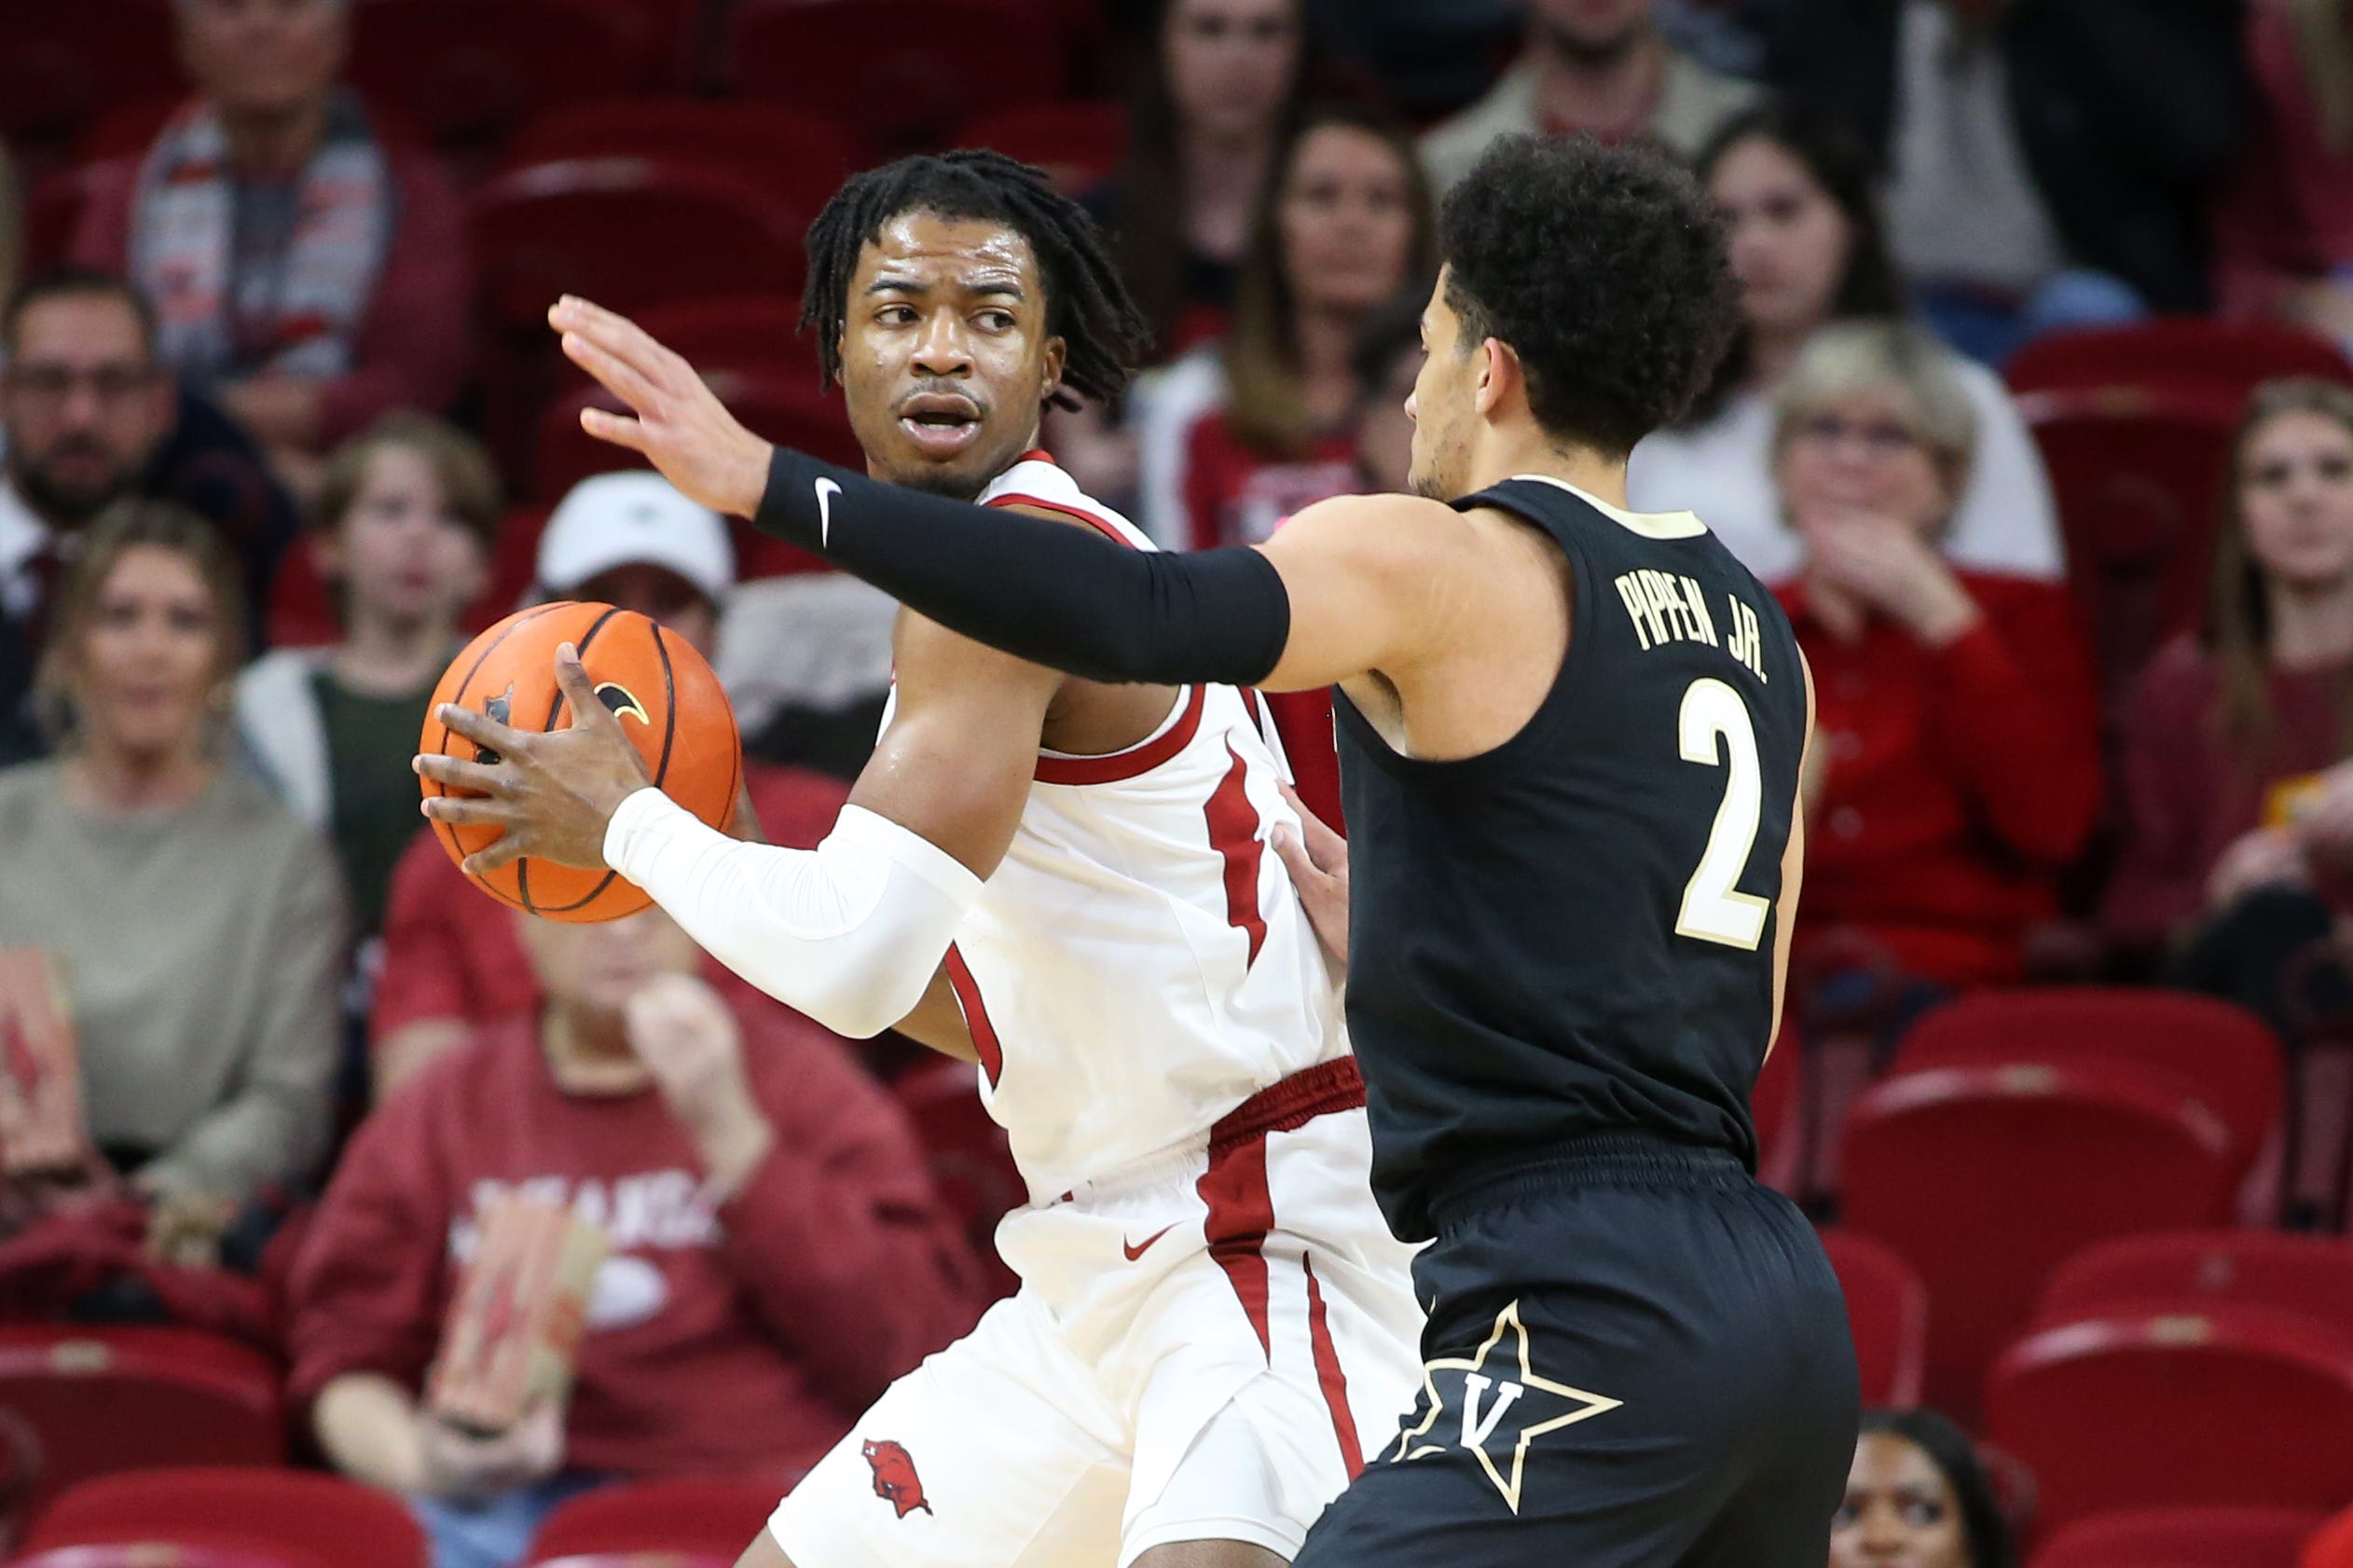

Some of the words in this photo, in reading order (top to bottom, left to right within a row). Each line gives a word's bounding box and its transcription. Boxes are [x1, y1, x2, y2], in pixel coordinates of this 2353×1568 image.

[1615, 569, 1718, 651] PIPPEN
[1727, 593, 1768, 684] JR.
[1675, 677, 1770, 951] 2
[1461, 1372, 1524, 1448] V
